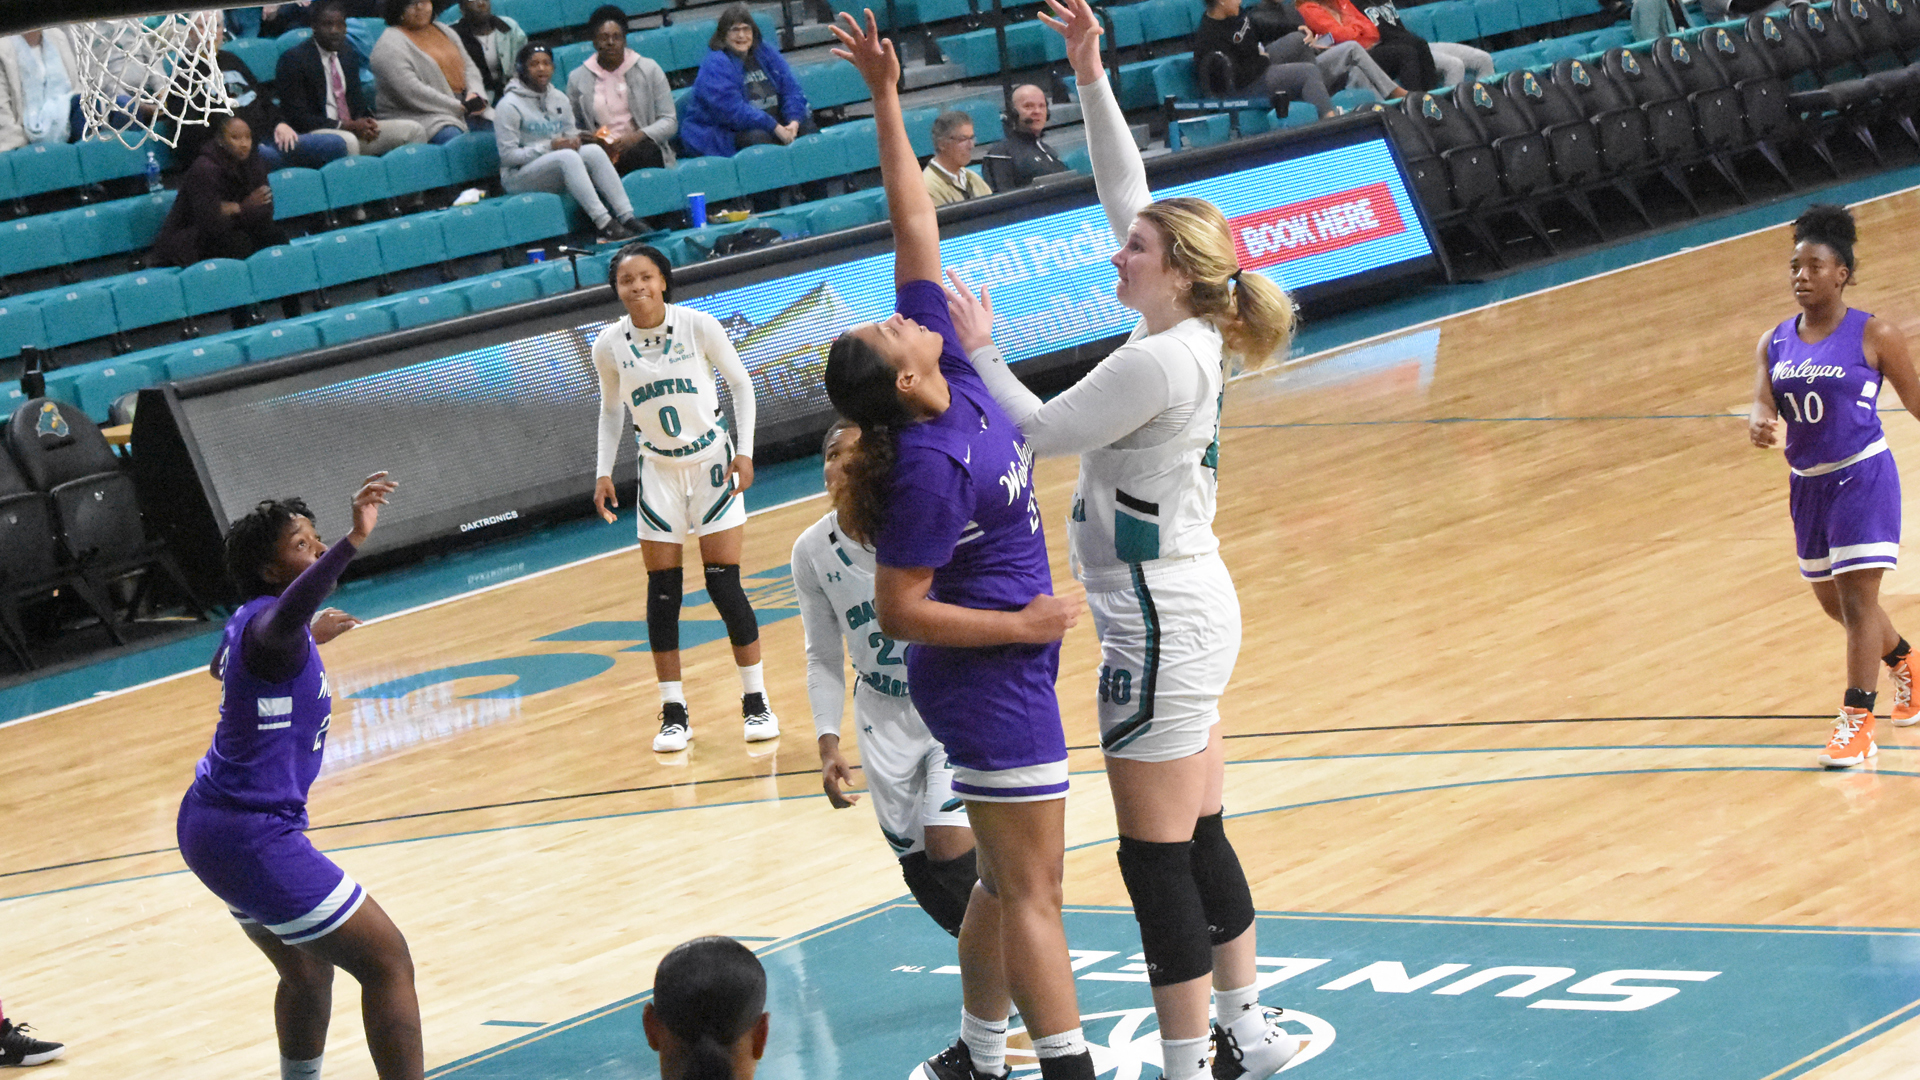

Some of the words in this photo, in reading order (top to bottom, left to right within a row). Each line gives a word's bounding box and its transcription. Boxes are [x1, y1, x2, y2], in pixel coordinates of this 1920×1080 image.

[1240, 210, 1318, 258] BOOK
[1310, 198, 1380, 241] HERE
[1771, 357, 1846, 384] Wesleyan
[631, 378, 698, 407] COASTAL
[1784, 391, 1824, 424] 10
[659, 405, 682, 437] 0
[710, 464, 724, 488] 0
[459, 510, 519, 532] DAKTRONICS
[845, 599, 877, 631] COA
[868, 632, 908, 667] 2
[1316, 960, 1723, 1011] SUN
